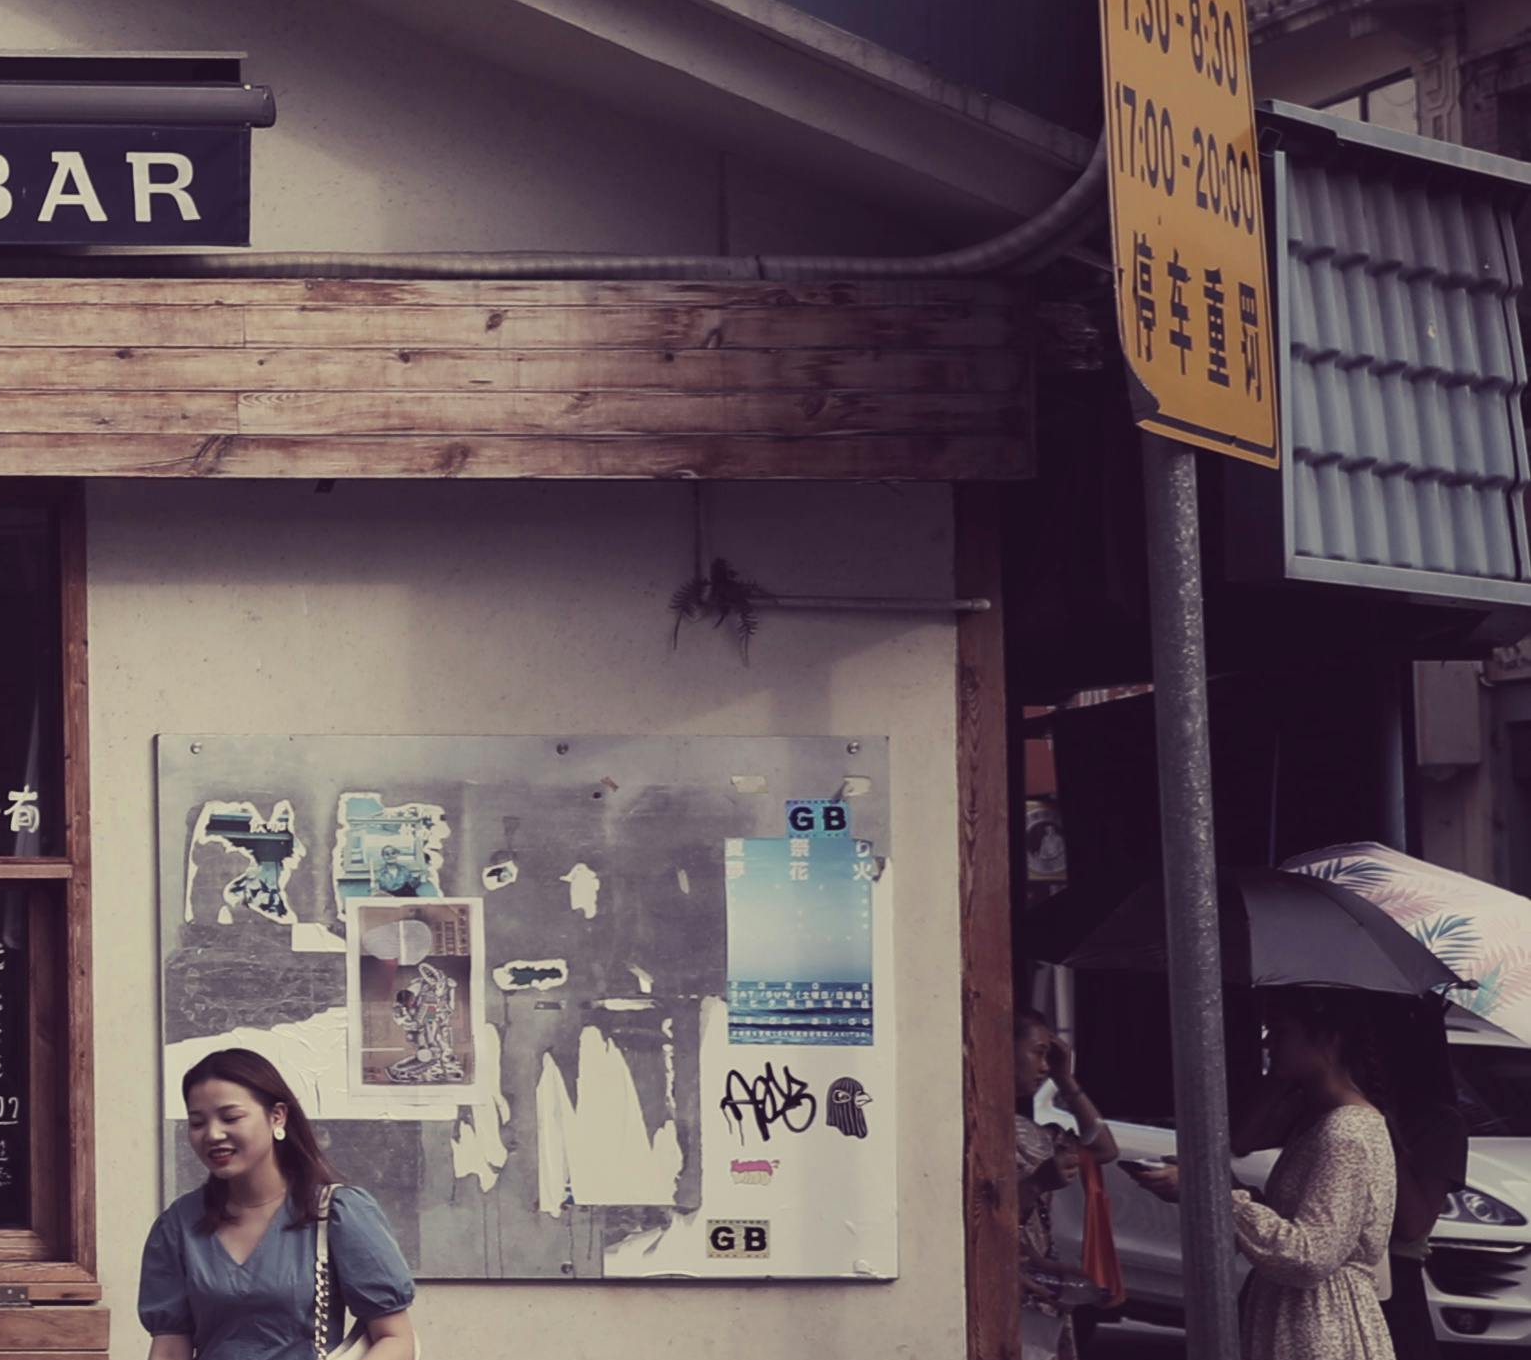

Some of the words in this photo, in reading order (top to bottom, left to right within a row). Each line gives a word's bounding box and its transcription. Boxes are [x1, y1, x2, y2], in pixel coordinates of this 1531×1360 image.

[1131, 231, 1262, 404] 停车重罚
[789, 806, 847, 832] GB
[710, 1226, 767, 1252] GB
